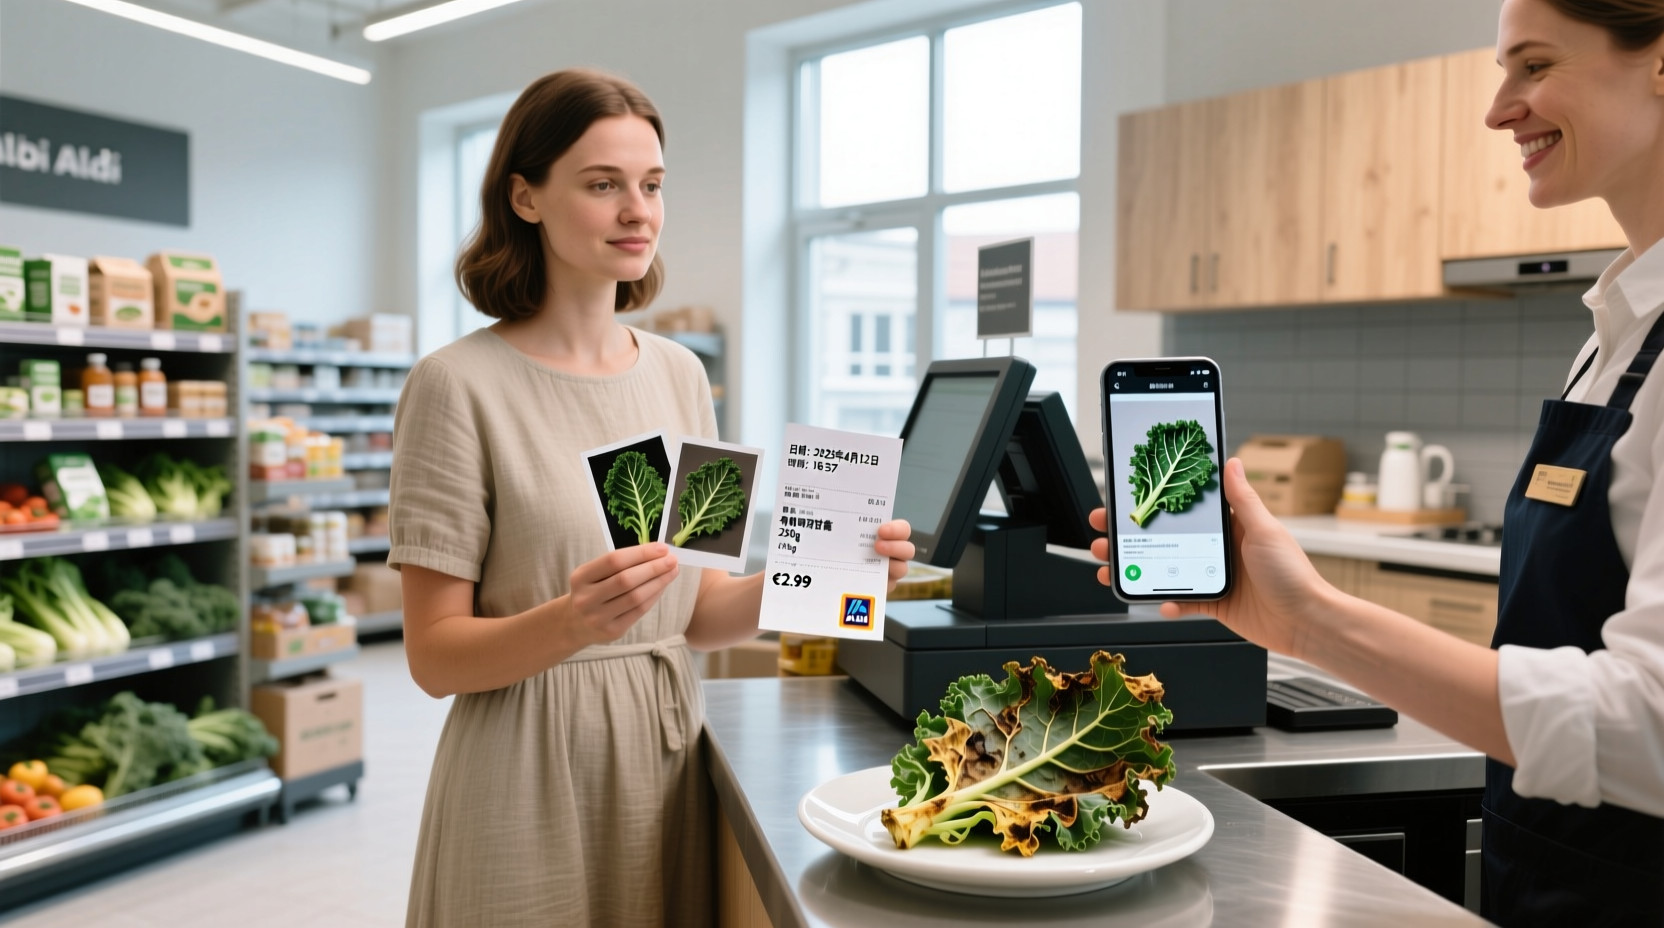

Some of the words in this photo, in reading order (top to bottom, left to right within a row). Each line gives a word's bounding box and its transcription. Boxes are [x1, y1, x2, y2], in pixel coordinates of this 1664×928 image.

[53, 143, 122, 185] Aldi
[778, 527, 801, 543] 250g
[772, 572, 812, 588] €2.99
